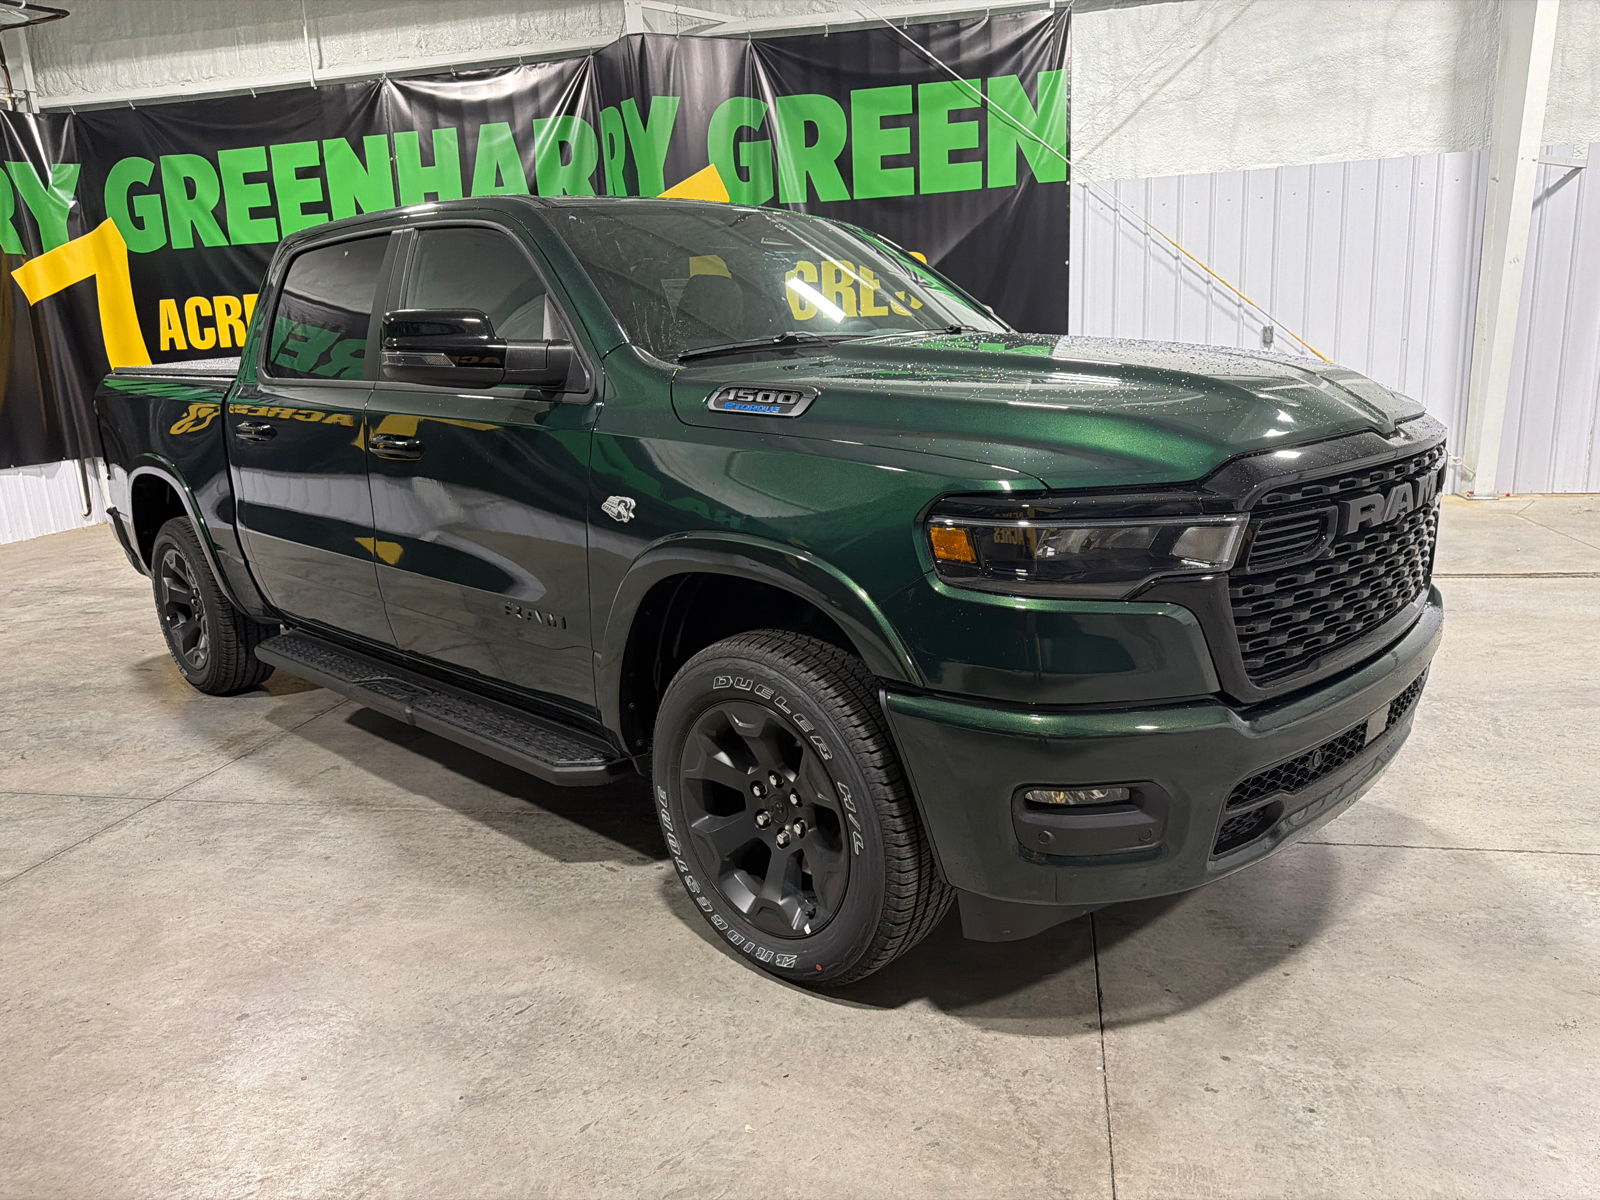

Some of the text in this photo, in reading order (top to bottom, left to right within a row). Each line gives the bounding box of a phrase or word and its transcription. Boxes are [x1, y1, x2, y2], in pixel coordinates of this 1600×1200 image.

[104, 133, 396, 254] GREEN
[394, 69, 1068, 207] HARRY GREEN
[10, 217, 152, 371] 7
[725, 389, 798, 405] 1500
[1342, 470, 1438, 536] RAM
[712, 675, 833, 761] DUELER
[657, 785, 798, 969] BRIDGESTONE
